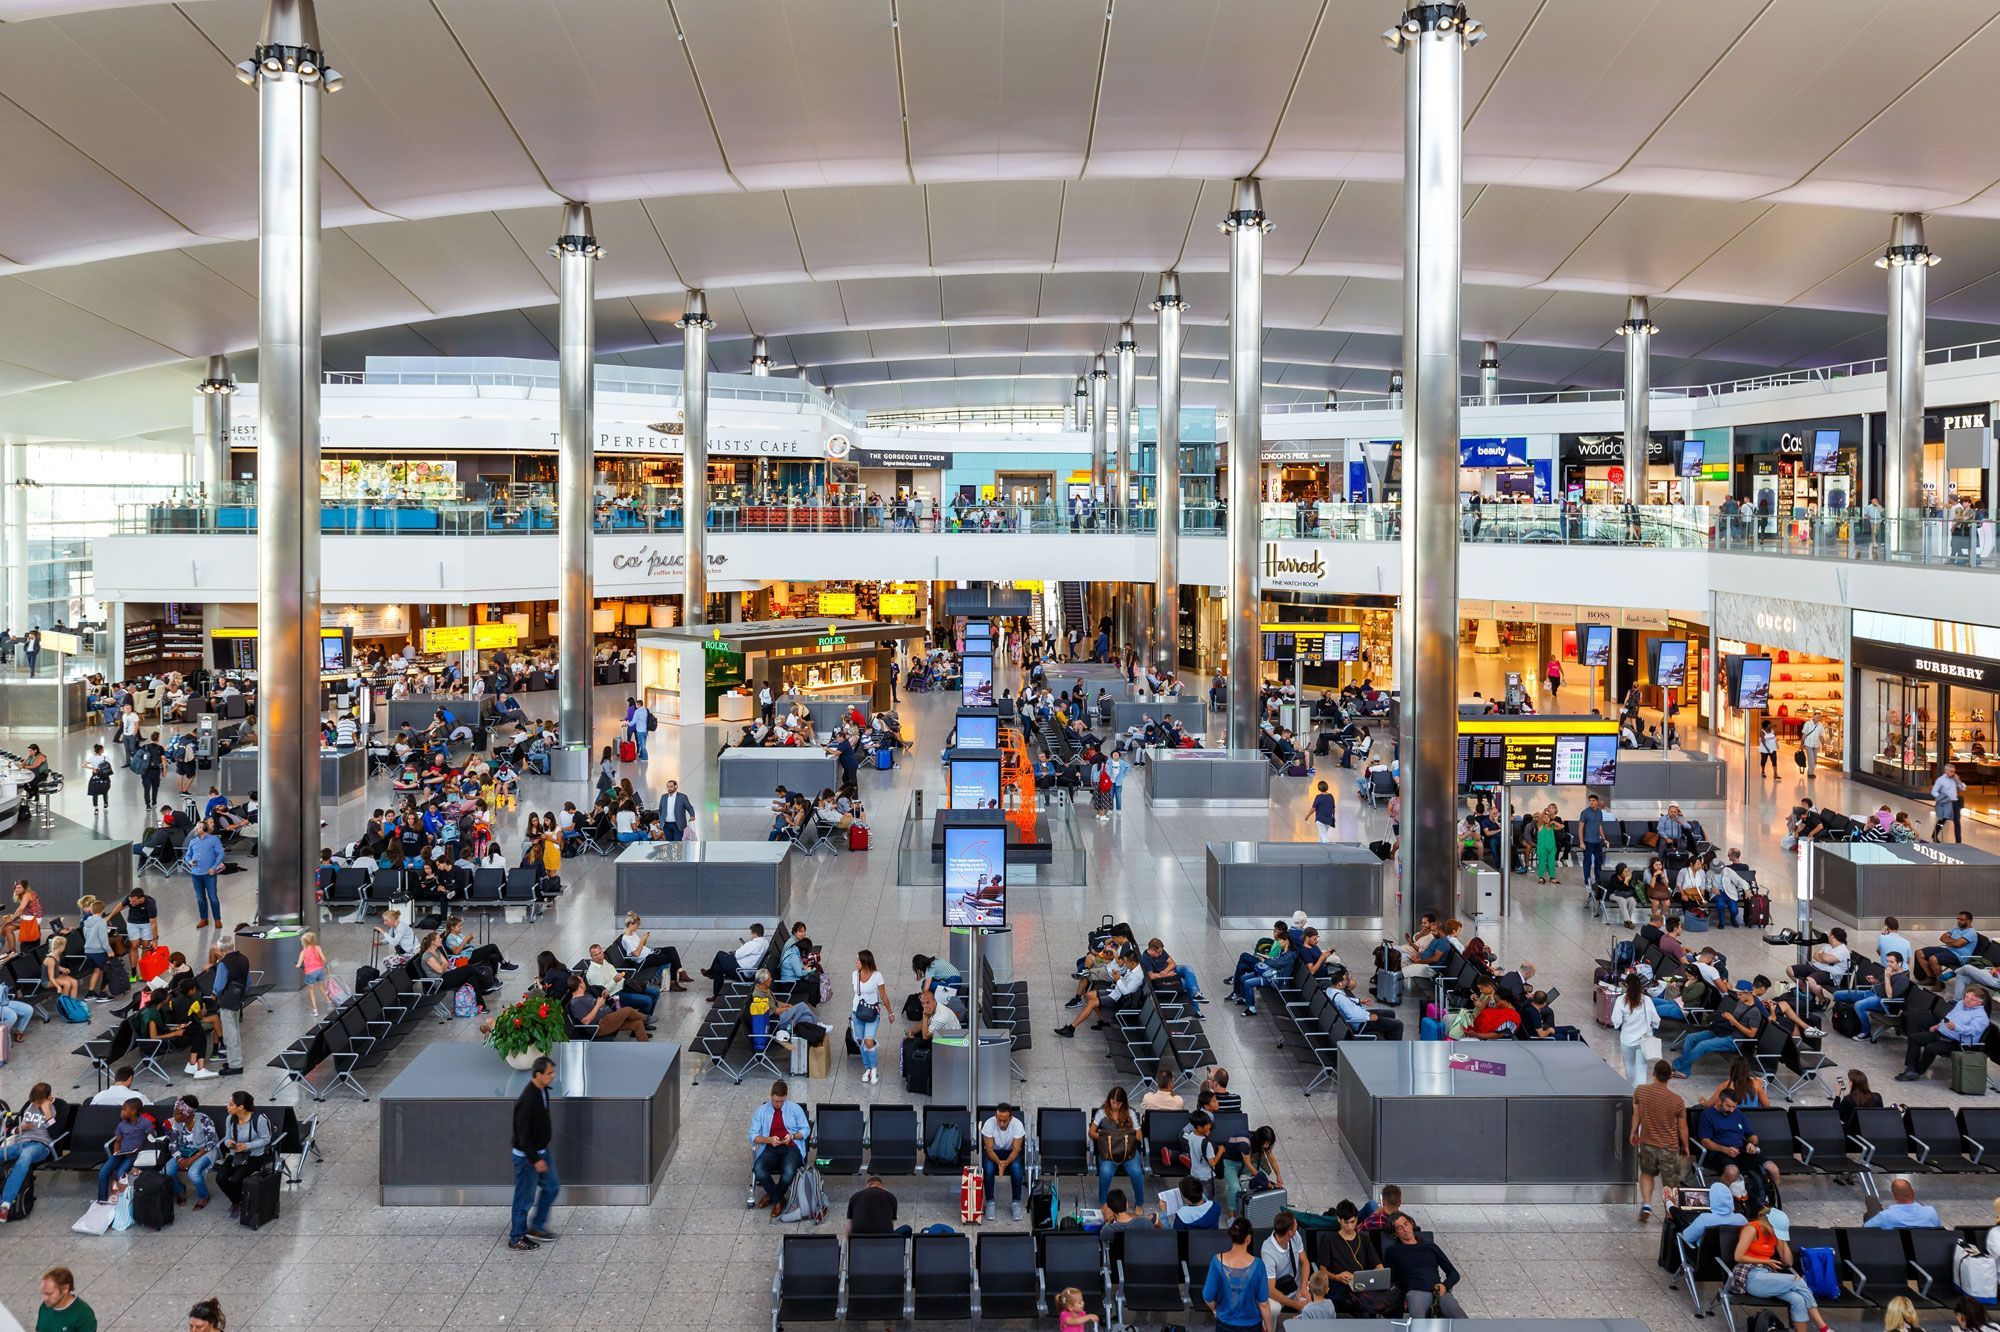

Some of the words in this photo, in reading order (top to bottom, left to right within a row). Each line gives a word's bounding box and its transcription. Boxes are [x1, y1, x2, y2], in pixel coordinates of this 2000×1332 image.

[1944, 414, 1985, 430] PINK
[231, 426, 257, 434] HEST
[601, 434, 752, 451] PERFECTNISTS'
[760, 440, 798, 452] CAFÉ
[1478, 446, 1506, 456] beauty
[1261, 543, 1326, 579] Harrods
[1757, 612, 1796, 633] GUCCI
[705, 640, 729, 650] ROLEX
[818, 636, 846, 646] ROLEX
[1915, 659, 1984, 680] BURBERRY
[1526, 774, 1549, 782] 17:53
